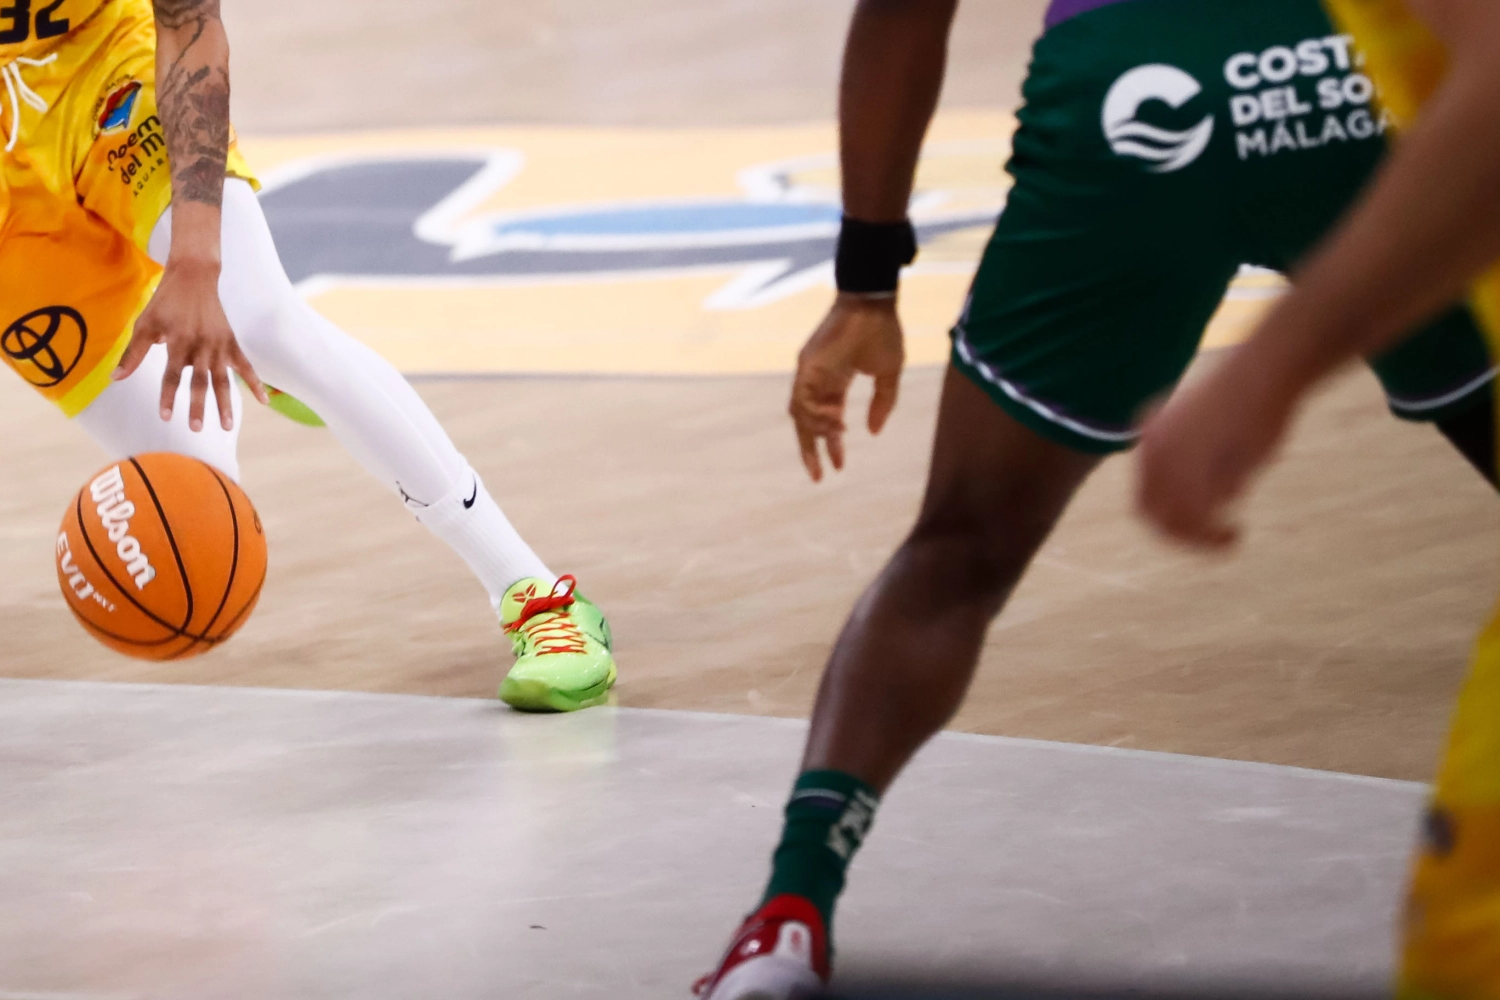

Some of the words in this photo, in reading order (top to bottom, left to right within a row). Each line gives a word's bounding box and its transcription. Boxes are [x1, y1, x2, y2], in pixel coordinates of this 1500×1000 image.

[1222, 34, 1366, 89] COST
[1229, 86, 1313, 127] DEL
[1315, 73, 1378, 110] SO
[107, 114, 161, 172] poem
[120, 153, 142, 185] del
[90, 464, 156, 591] Wilson
